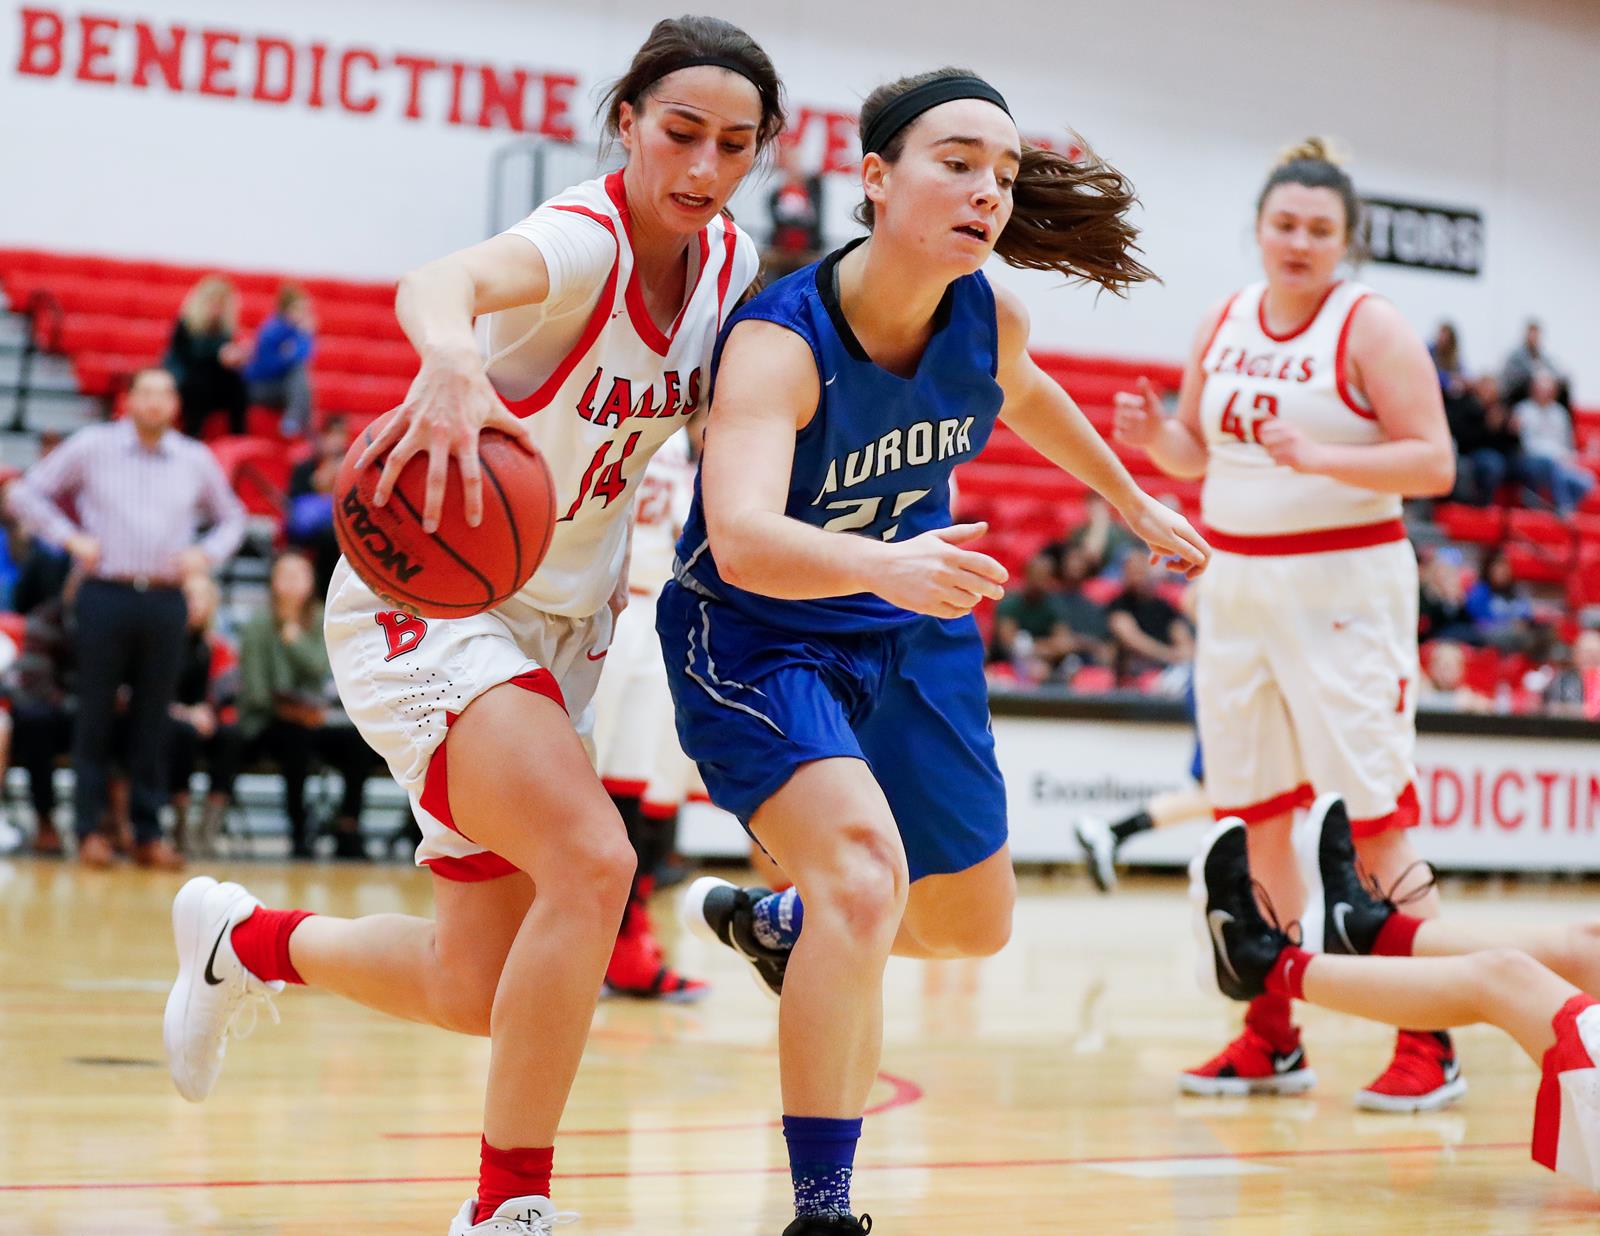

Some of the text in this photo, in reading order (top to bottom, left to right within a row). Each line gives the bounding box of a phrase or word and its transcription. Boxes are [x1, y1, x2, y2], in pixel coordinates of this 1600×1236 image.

[17, 7, 578, 141] BENEDICTINE
[1213, 346, 1315, 383] EAGLES
[556, 431, 643, 523] 14
[810, 415, 975, 506] AURORA
[342, 485, 424, 583] NCAA
[374, 611, 428, 662] B
